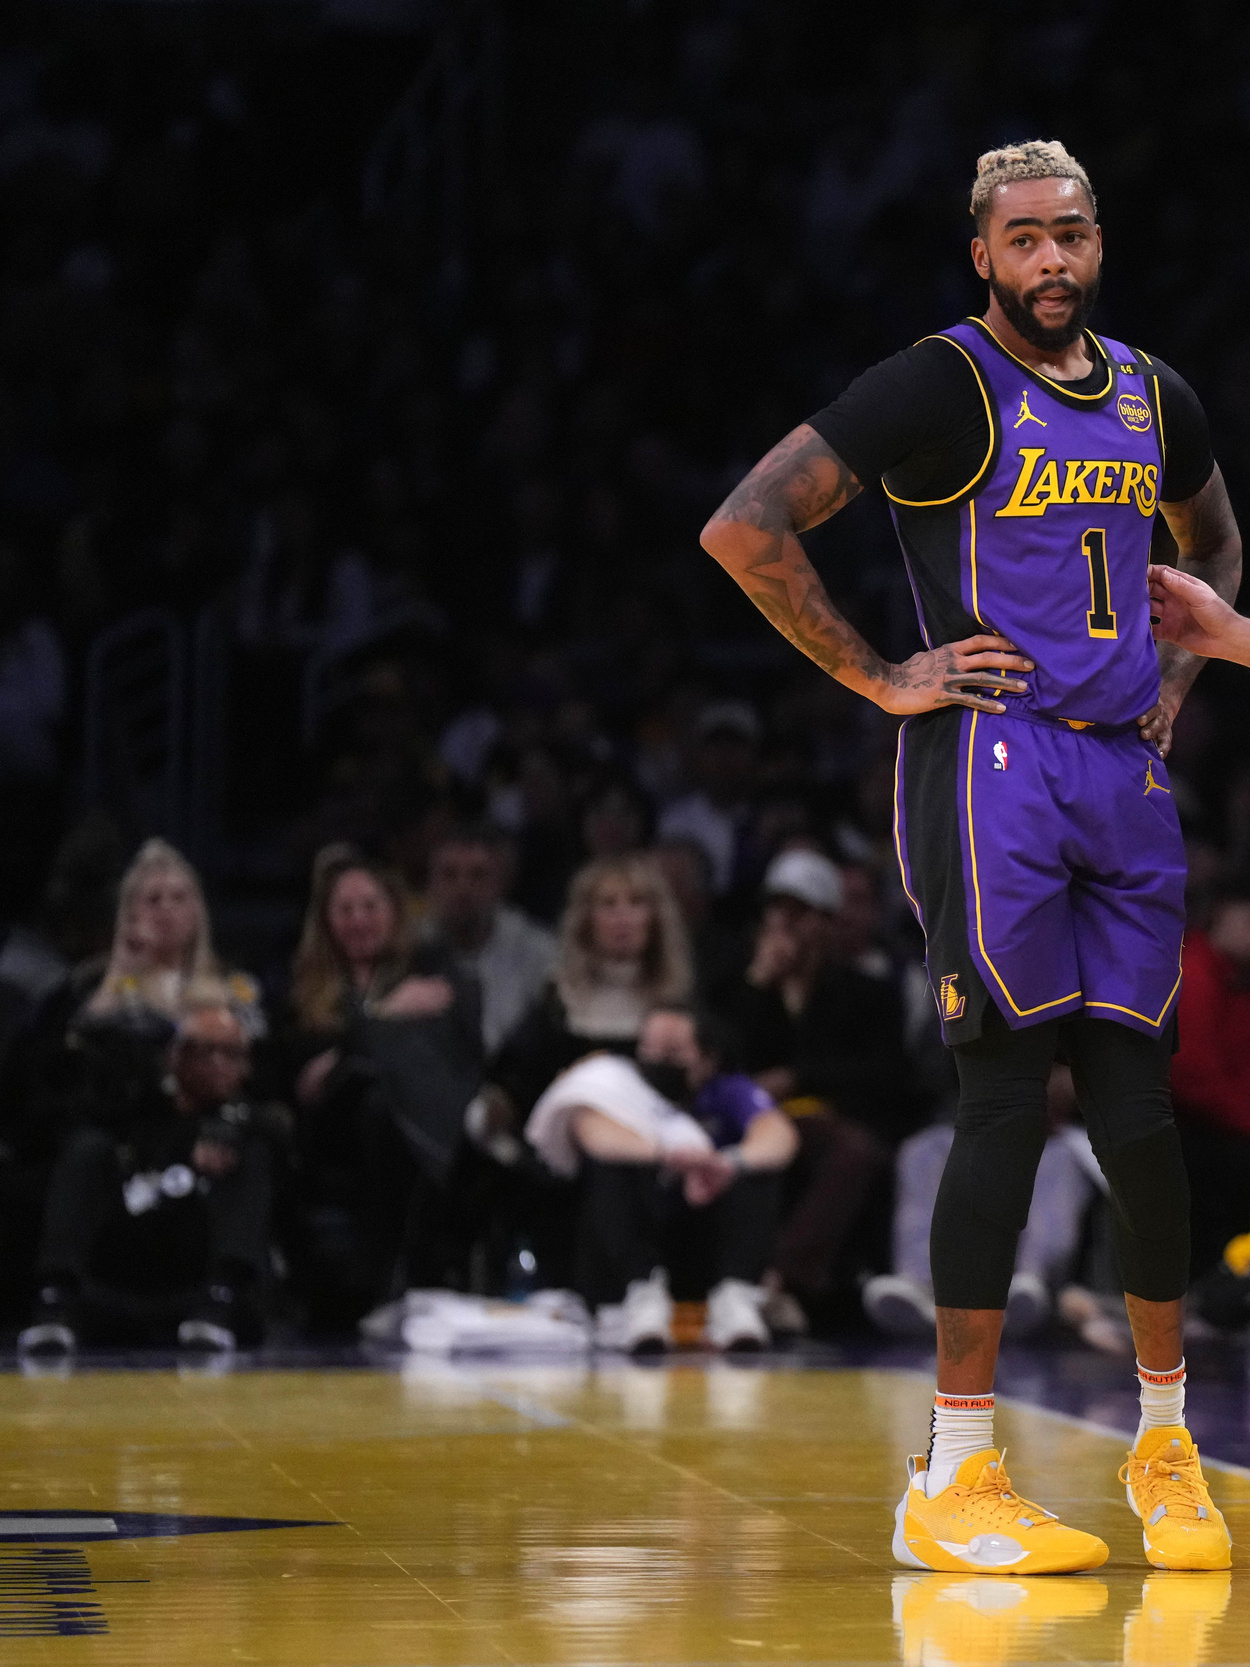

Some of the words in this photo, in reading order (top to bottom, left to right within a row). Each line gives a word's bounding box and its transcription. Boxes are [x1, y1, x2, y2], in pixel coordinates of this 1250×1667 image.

[1119, 403, 1149, 422] bibigo
[994, 447, 1158, 518] LAKERS
[1081, 528, 1118, 639] 1
[944, 1399, 968, 1407] NBA
